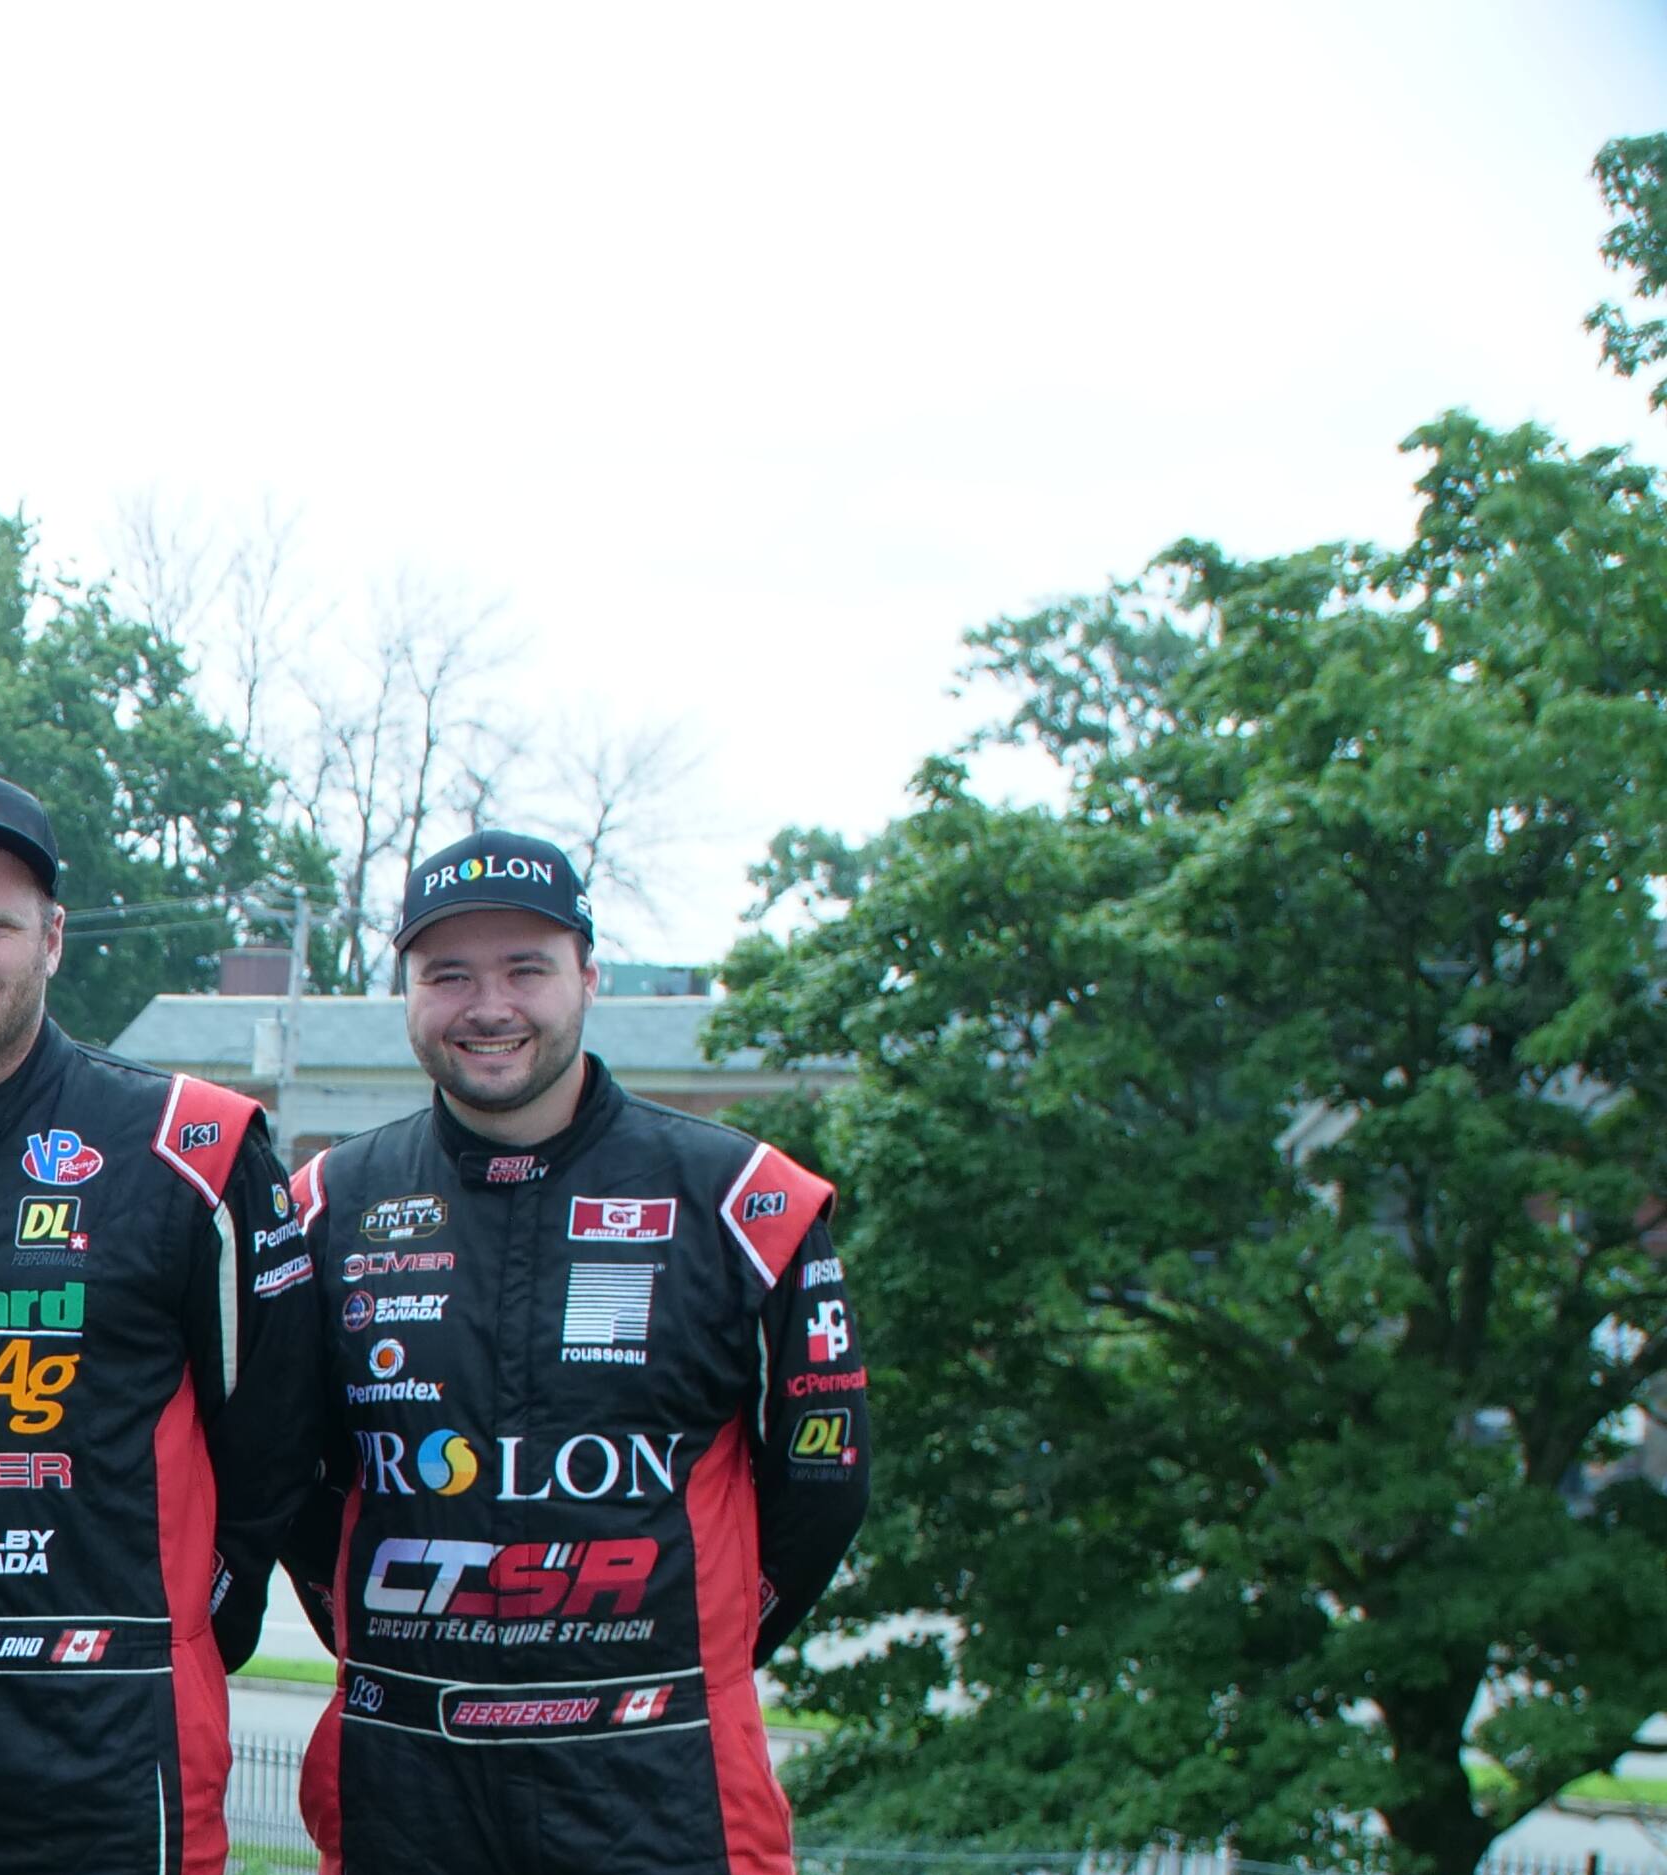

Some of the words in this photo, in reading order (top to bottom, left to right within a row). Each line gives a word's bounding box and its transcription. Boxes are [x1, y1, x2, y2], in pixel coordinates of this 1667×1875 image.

[423, 854, 554, 897] PROLON
[179, 1121, 219, 1153] K1
[27, 1129, 82, 1185] VP
[58, 1156, 101, 1177] Racing
[365, 1205, 443, 1229] PINTY'S
[743, 1192, 787, 1222] K1
[21, 1203, 70, 1240] DL
[11, 1250, 87, 1268] PERFORMANCE
[344, 1252, 455, 1277] OLIVIER
[375, 1294, 450, 1310] SHELBY
[375, 1307, 443, 1324] CANADA
[561, 1347, 647, 1365] rousseau
[346, 1377, 445, 1405] Permatex
[794, 1417, 843, 1455] DL
[369, 1617, 429, 1641] CIRCUIT
[558, 1619, 655, 1643] ST-ROCH
[452, 1697, 599, 1726] BERGERON
